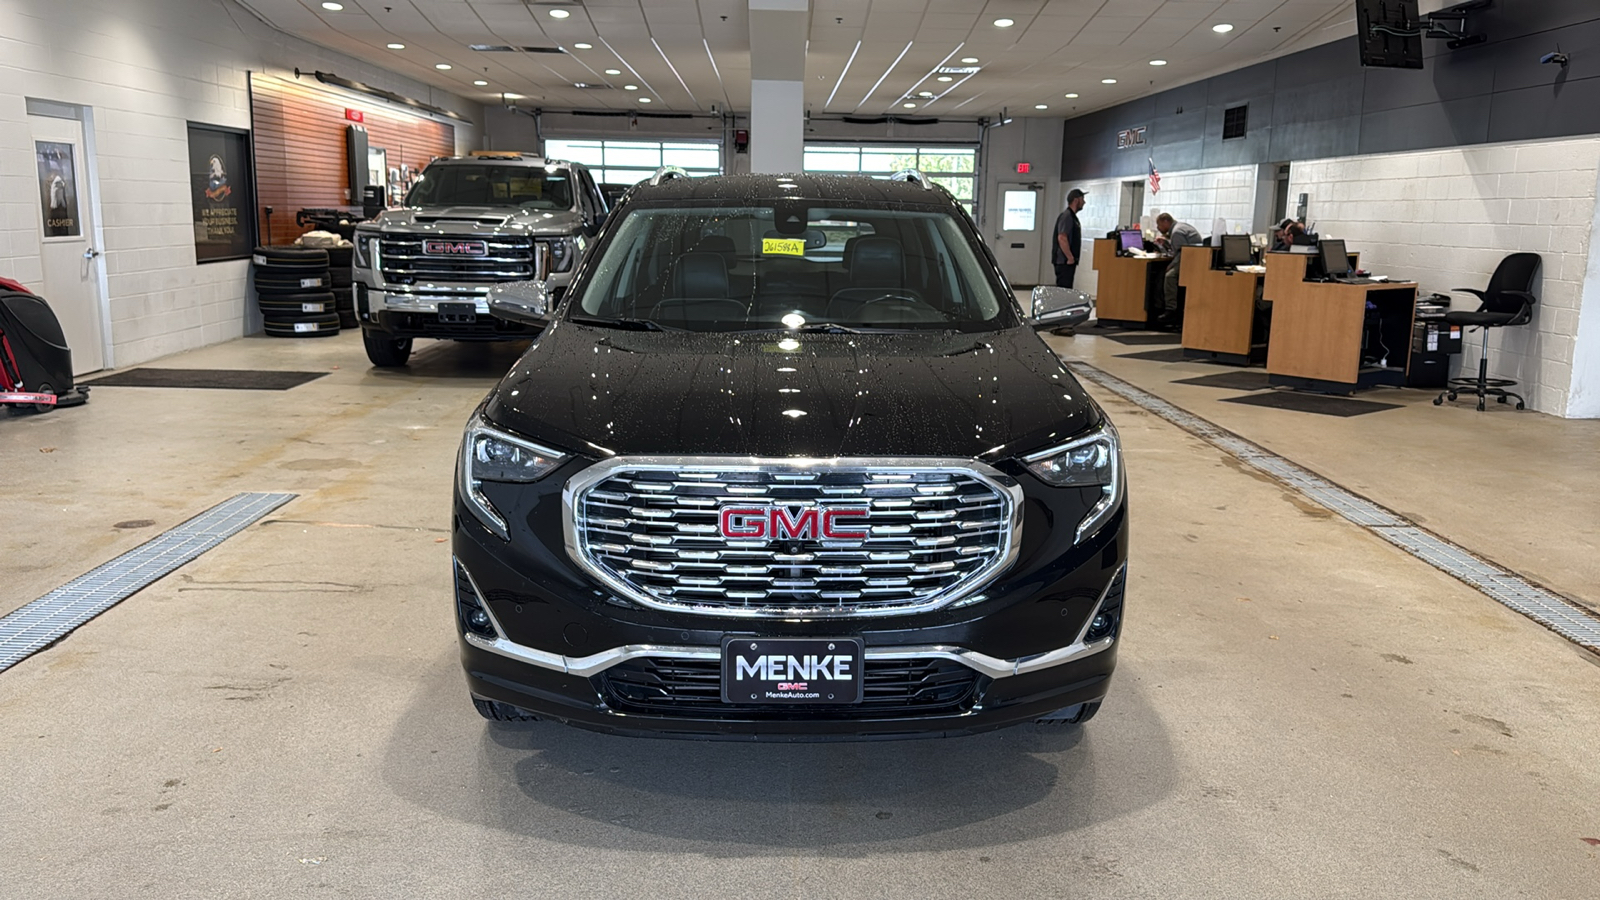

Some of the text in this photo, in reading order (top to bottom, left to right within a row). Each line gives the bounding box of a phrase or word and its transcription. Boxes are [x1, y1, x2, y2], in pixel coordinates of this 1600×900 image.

[1117, 126, 1147, 149] GMC
[1018, 163, 1030, 173] EXIT
[47, 218, 74, 227] CASHIER
[427, 242, 484, 254] GMC
[719, 503, 871, 540] GMC
[736, 655, 853, 680] MENKE
[777, 682, 808, 690] GMC
[765, 691, 820, 699] MenkeAuto.com
